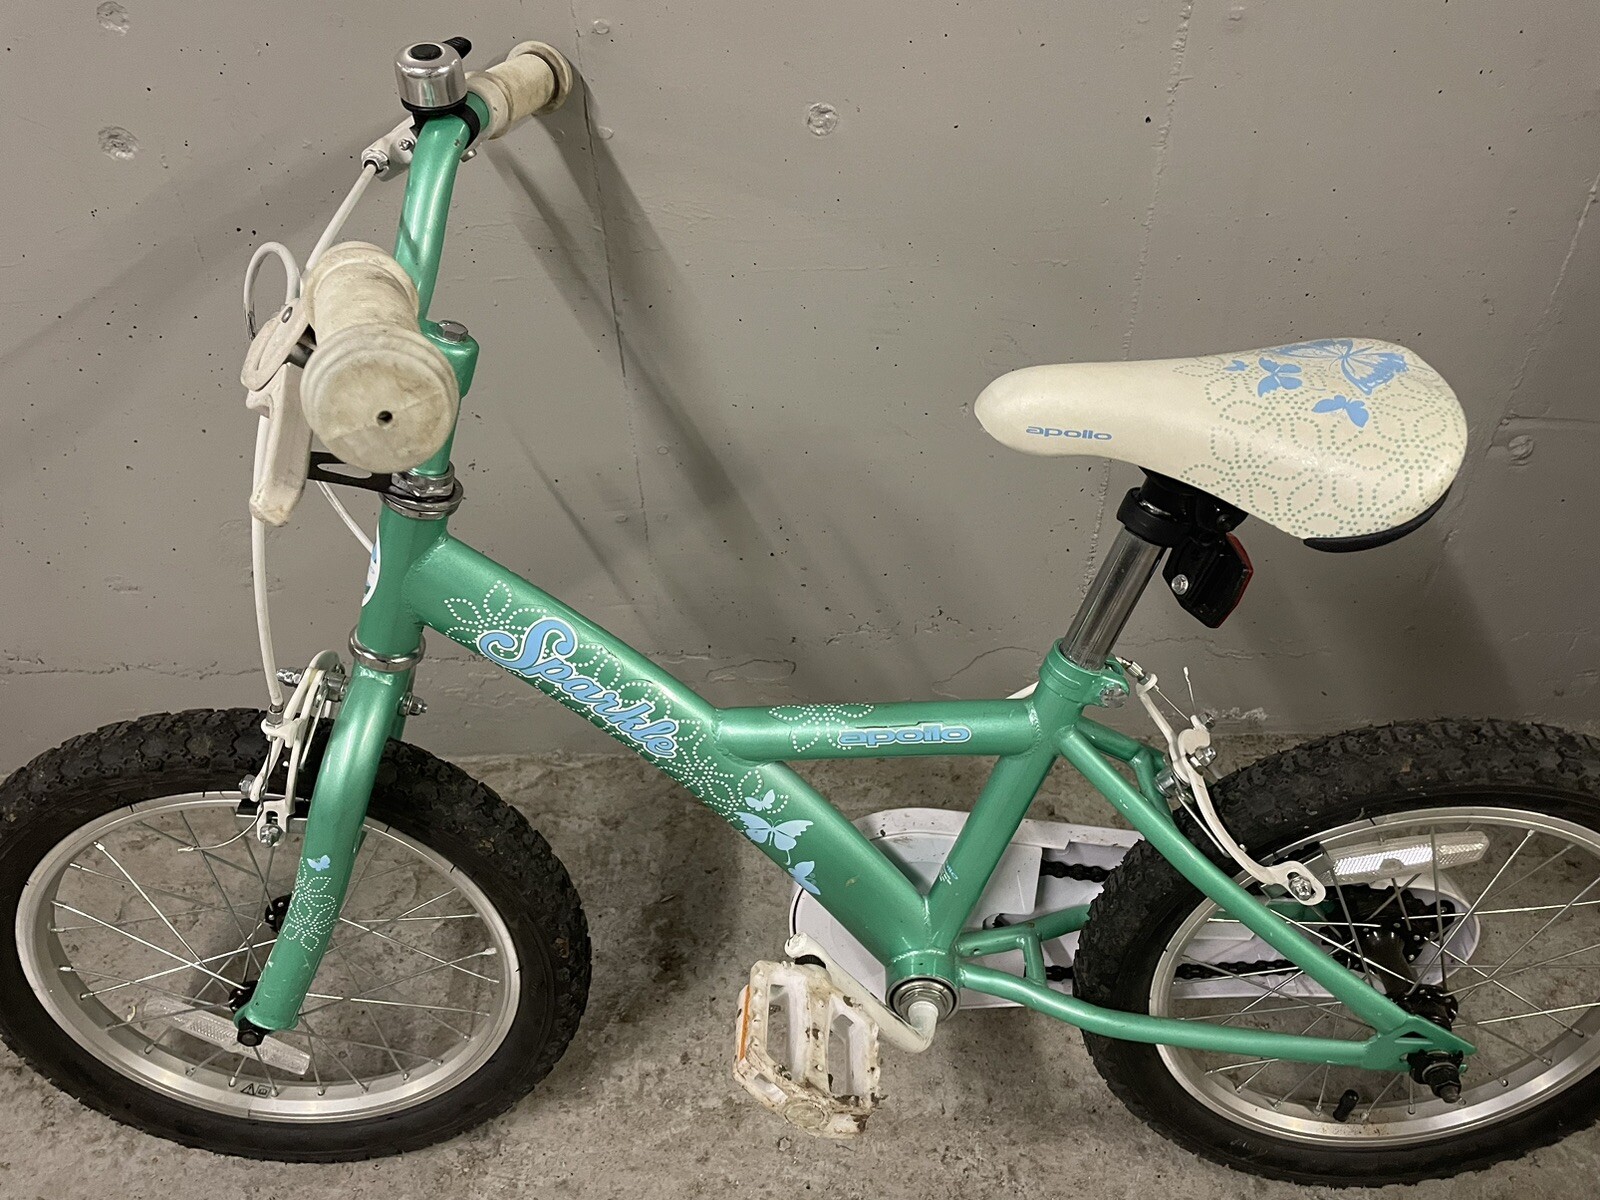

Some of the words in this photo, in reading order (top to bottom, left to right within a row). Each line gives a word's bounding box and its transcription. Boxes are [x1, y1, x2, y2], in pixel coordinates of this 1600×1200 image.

[1025, 426, 1112, 440] apollo
[477, 617, 678, 757] Sparkle
[838, 723, 971, 747] apollo
